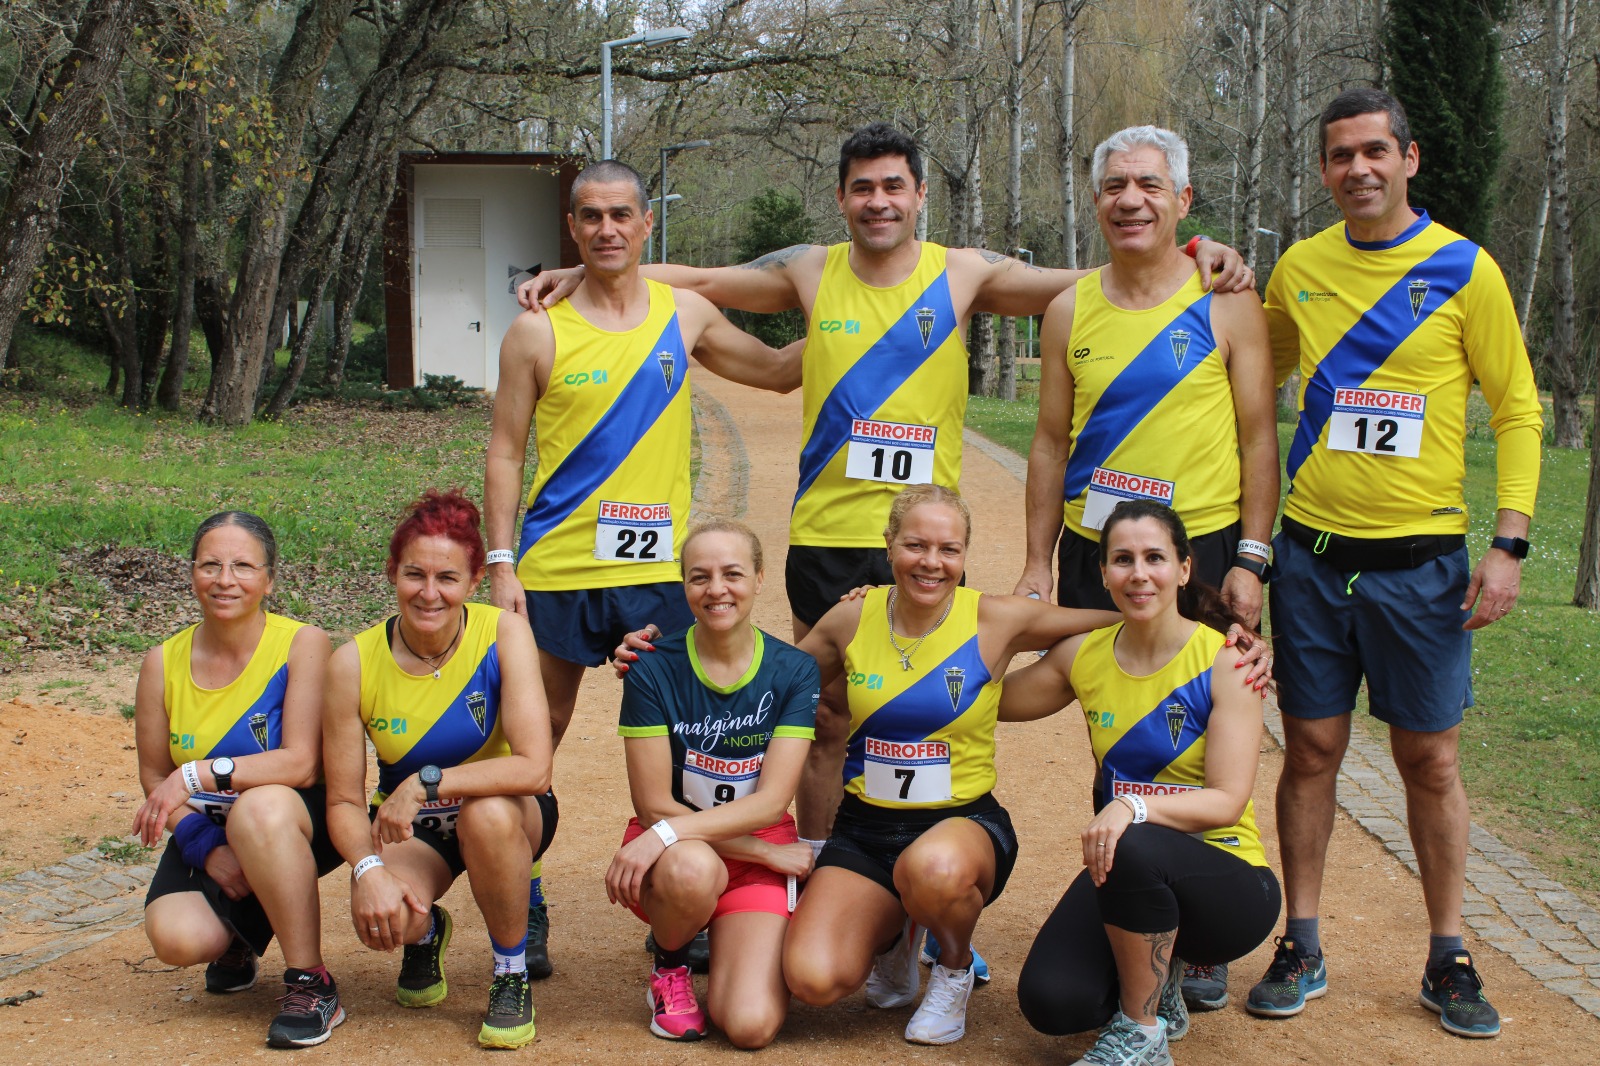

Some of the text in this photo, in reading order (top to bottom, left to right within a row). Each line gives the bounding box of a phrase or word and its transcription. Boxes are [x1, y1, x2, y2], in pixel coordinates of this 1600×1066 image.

[1335, 390, 1422, 411] FERROFER
[853, 421, 933, 442] FERROFER
[1354, 417, 1399, 452] 12
[871, 447, 913, 481] 10
[1092, 469, 1171, 498] FERROFER
[601, 503, 671, 520] FERROFER
[615, 529, 659, 559] 22
[673, 691, 774, 752] marginal
[731, 733, 765, 747] NOITE
[866, 738, 947, 758] FERROFER
[713, 784, 735, 807] 9
[894, 769, 915, 799] 7
[1114, 781, 1196, 796] FERROF
[205, 804, 228, 828] 5
